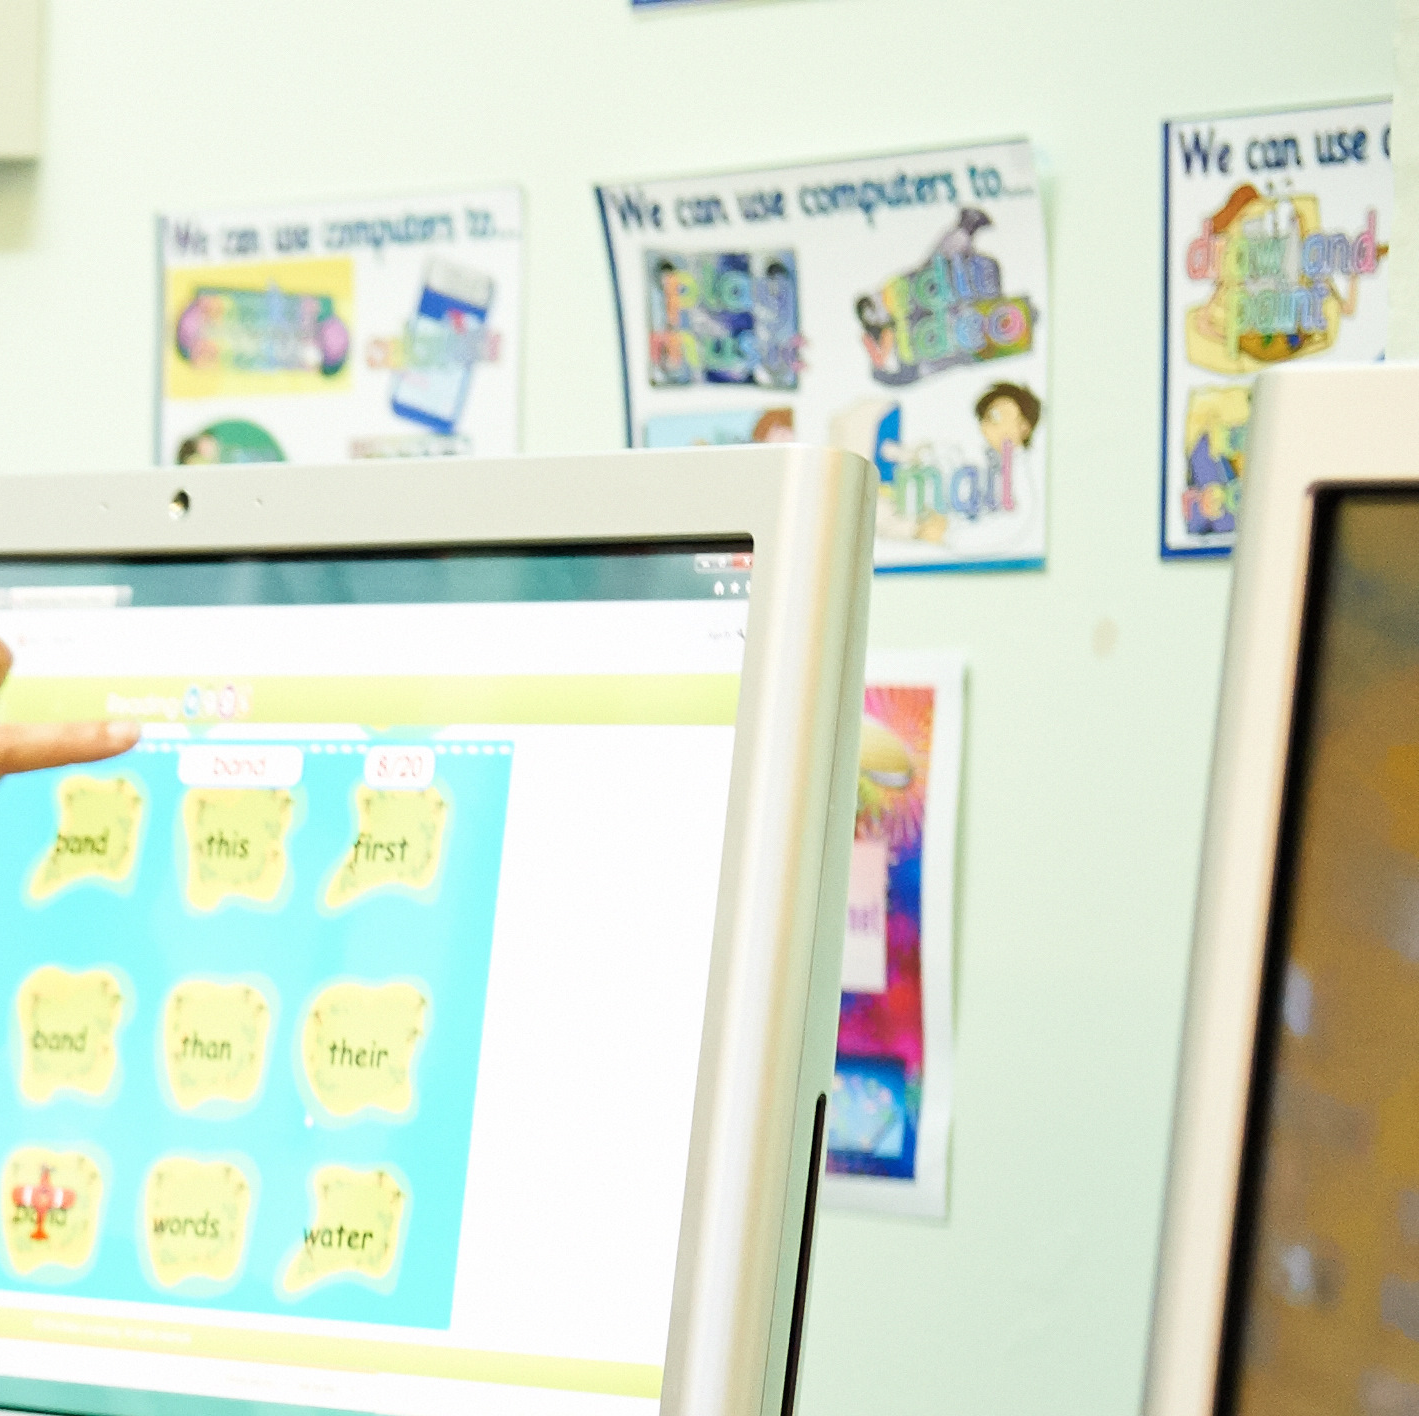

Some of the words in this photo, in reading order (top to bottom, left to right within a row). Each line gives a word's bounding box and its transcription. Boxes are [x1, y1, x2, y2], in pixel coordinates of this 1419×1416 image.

[1178, 125, 1232, 175] We
[1246, 136, 1302, 171] can
[1315, 129, 1367, 165] use
[1302, 208, 1378, 276] and
[205, 829, 251, 860] this
[352, 831, 410, 864] first
[32, 1027, 88, 1054] band
[181, 1032, 233, 1062] than
[329, 1038, 390, 1070] their
[153, 1211, 221, 1240] words
[303, 1226, 375, 1251] water
